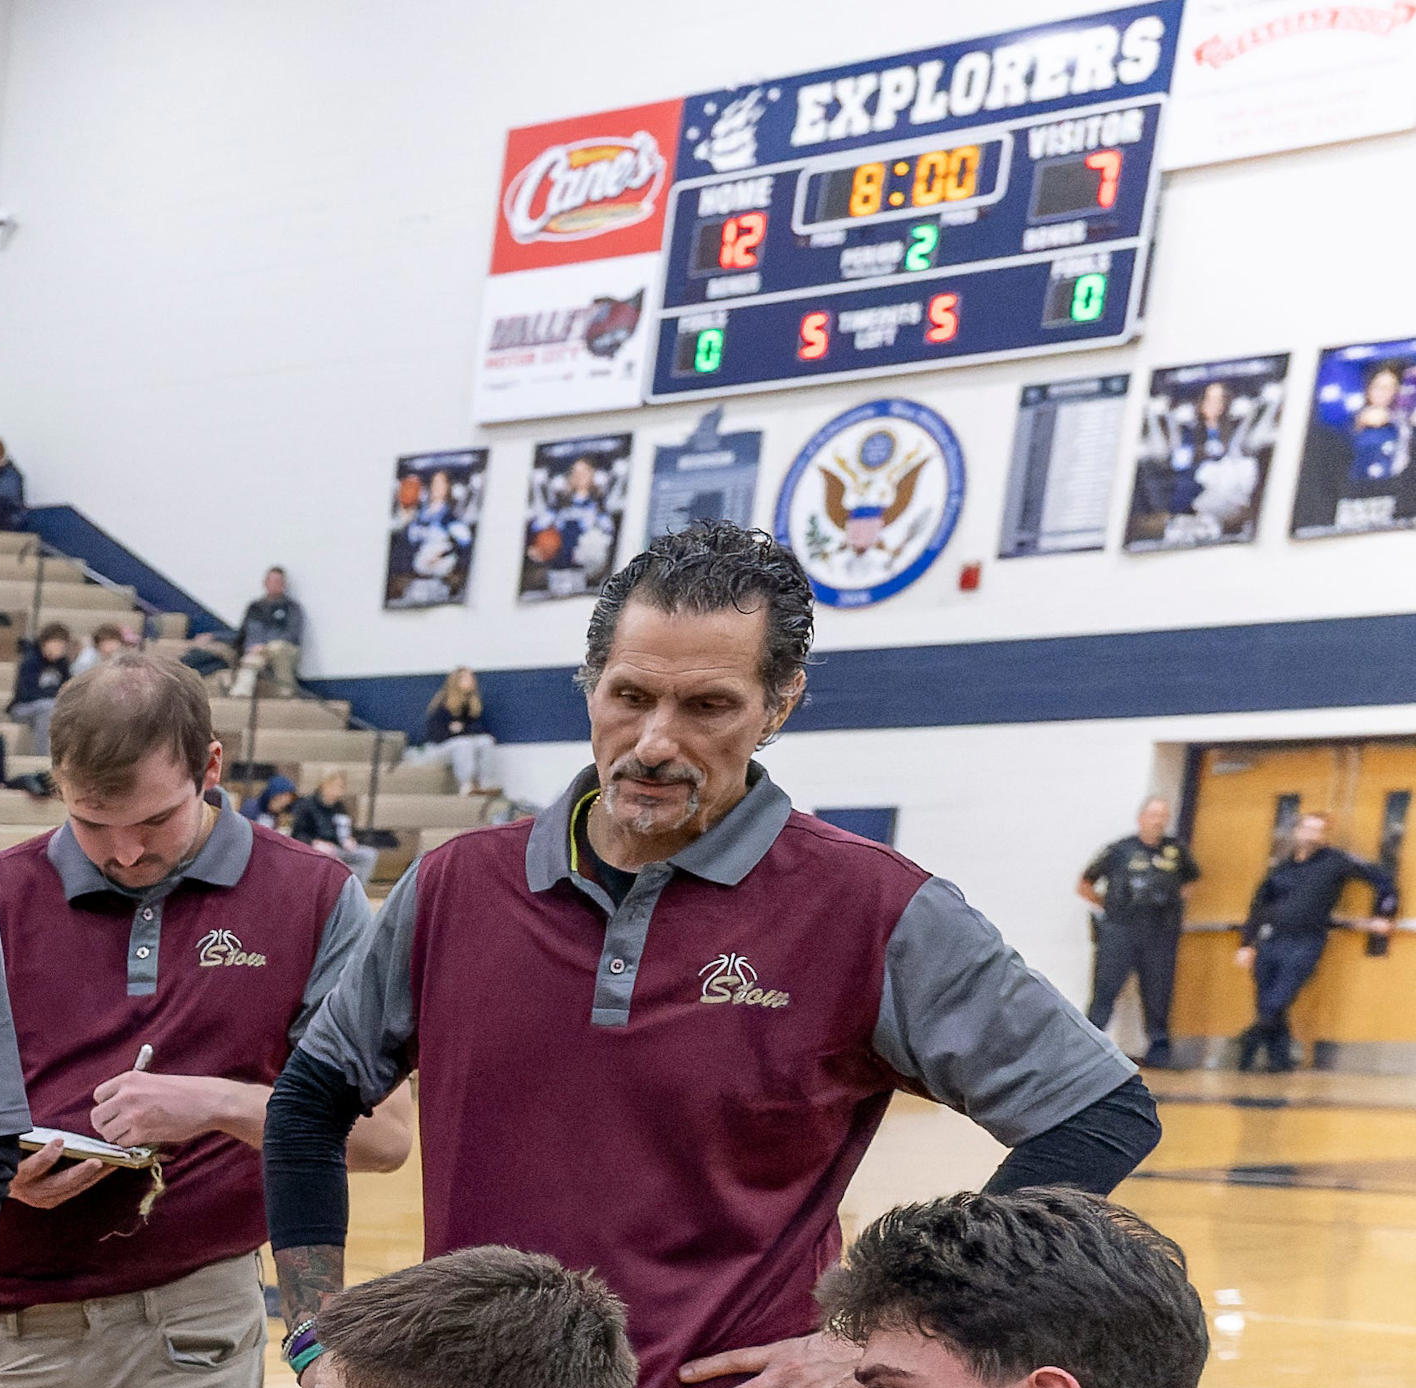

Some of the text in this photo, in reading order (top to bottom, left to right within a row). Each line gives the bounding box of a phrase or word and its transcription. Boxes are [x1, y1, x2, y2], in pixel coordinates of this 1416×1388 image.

[790, 16, 1166, 147] EXPLORERS
[1028, 108, 1145, 160] VISITOR
[697, 176, 774, 218] HOME
[848, 145, 981, 218] 8:00
[1085, 149, 1123, 209] 7
[718, 211, 767, 270] 12
[904, 224, 939, 272] 2
[926, 293, 959, 344] 5
[1070, 272, 1106, 322] 0
[694, 328, 726, 374] 0
[797, 311, 830, 361] 5
[198, 943, 267, 968] Stow
[699, 974, 790, 1009] Stow
